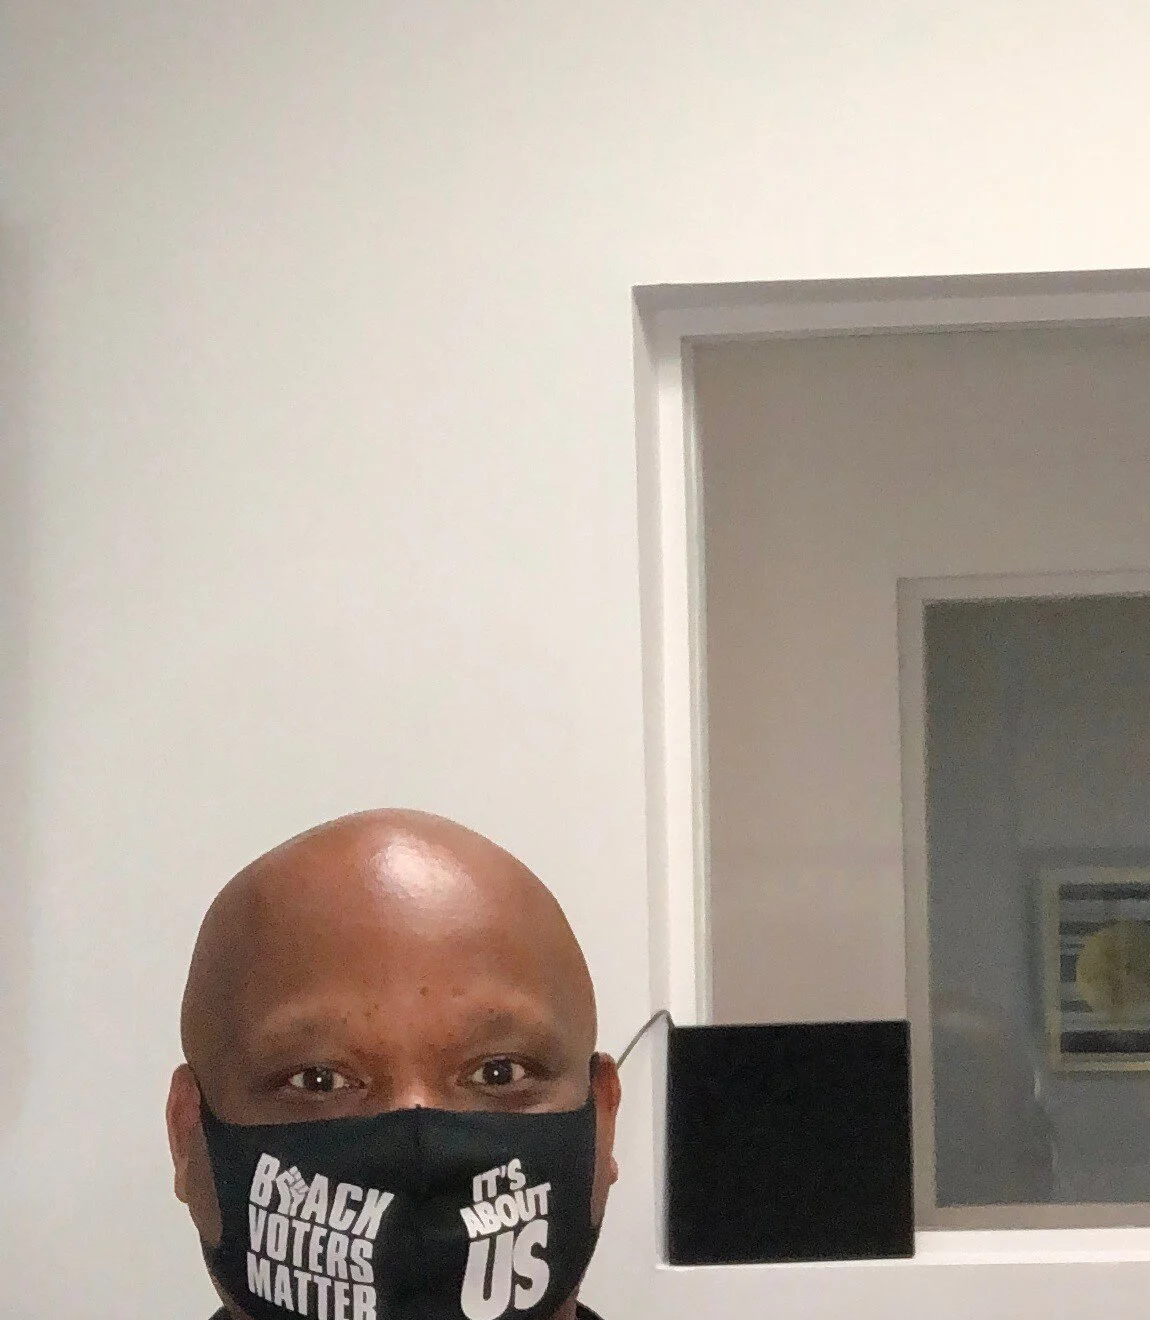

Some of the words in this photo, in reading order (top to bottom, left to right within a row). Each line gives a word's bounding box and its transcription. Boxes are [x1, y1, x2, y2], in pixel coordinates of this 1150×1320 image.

[472, 1158, 526, 1202] IT'S
[460, 1182, 552, 1240] ABOUT
[248, 1204, 374, 1284] VOTERS
